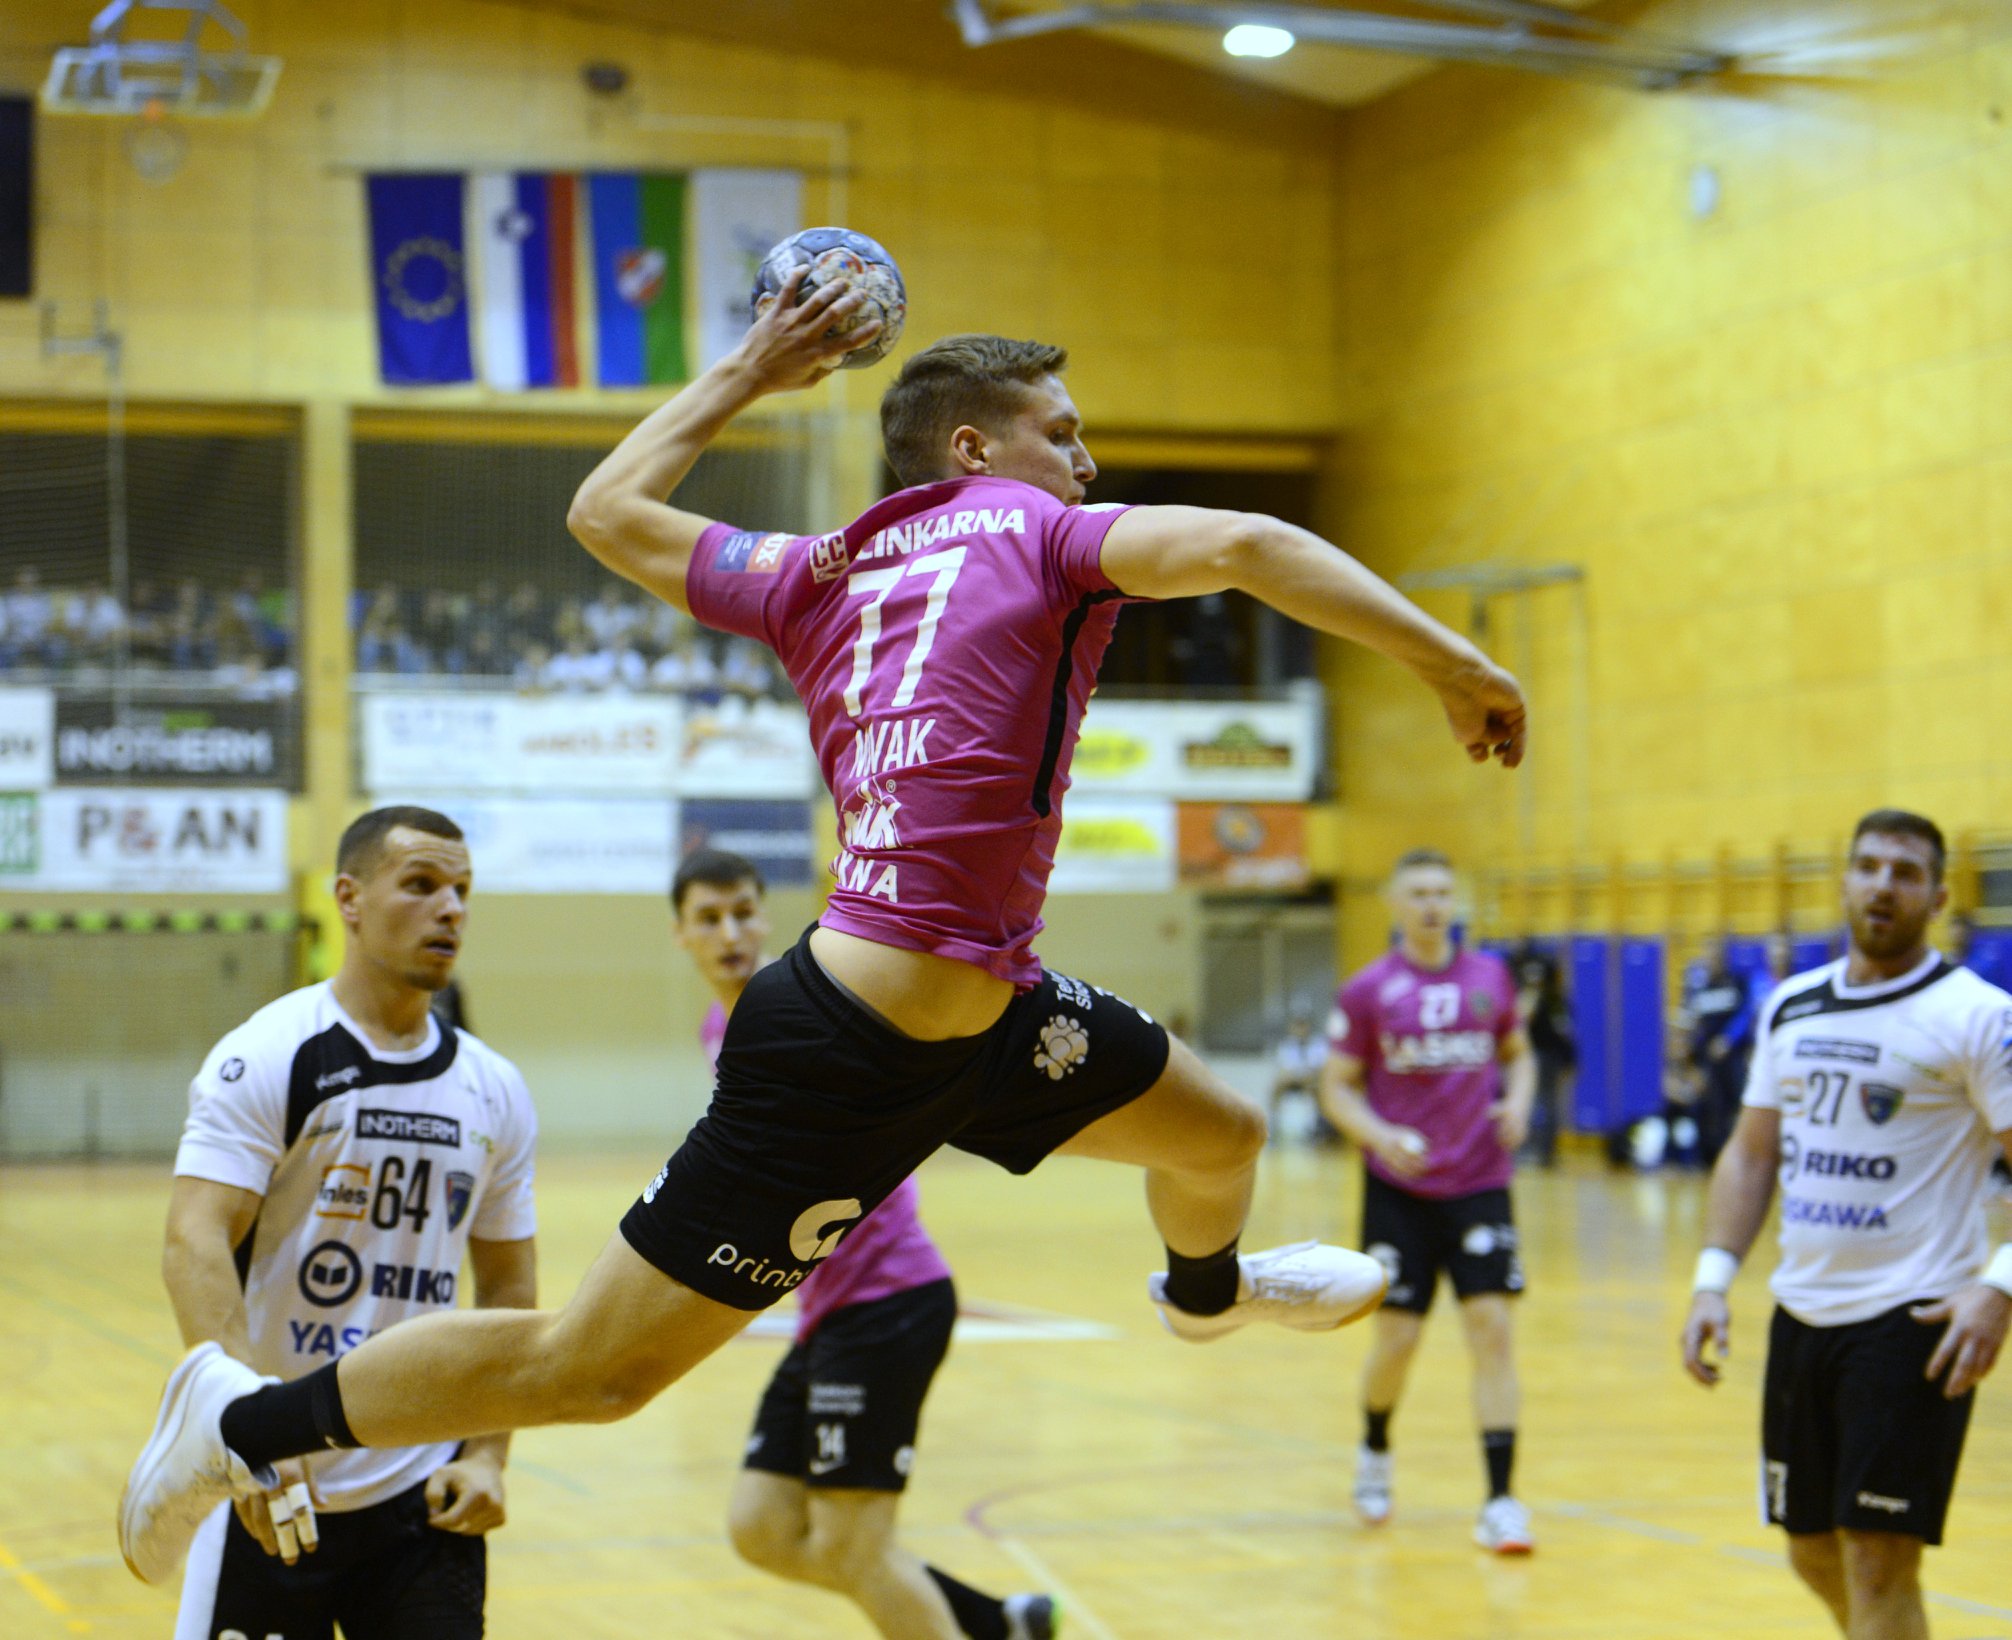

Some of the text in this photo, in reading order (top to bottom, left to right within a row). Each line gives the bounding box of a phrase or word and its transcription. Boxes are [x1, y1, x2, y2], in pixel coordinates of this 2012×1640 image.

[842, 545, 968, 718] 77
[1808, 1070, 1850, 1125] 27
[360, 1113, 458, 1142] INOTHERM
[1805, 1151, 1896, 1180] RIKO
[371, 1155, 432, 1233] 64
[372, 1263, 455, 1304] RIKO
[288, 1320, 368, 1357] YAS
